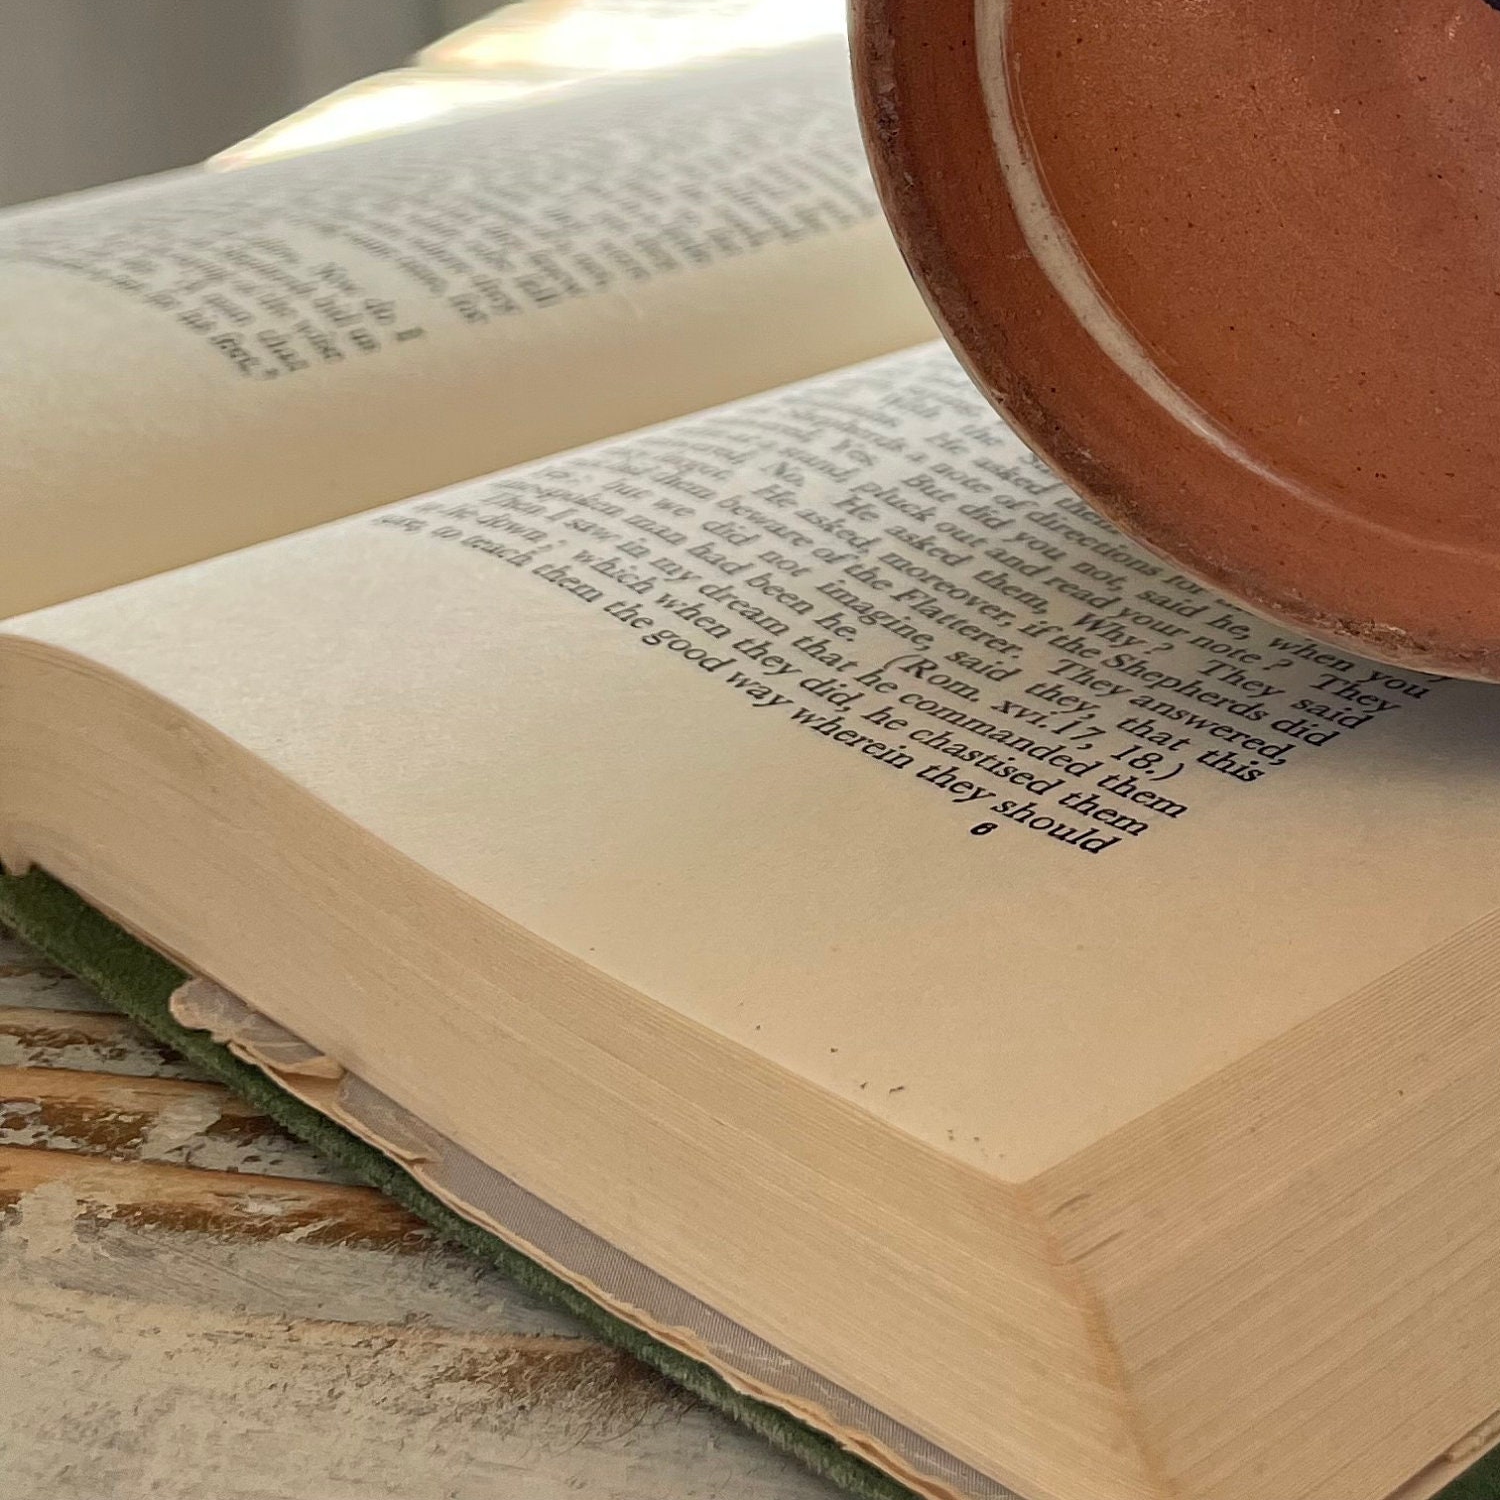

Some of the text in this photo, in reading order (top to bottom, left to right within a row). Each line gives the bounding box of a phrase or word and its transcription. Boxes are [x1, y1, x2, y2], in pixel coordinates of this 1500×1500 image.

[562, 517, 625, 541] saw
[616, 537, 653, 560] in
[650, 557, 704, 582] my
[698, 583, 790, 636] dream
[790, 634, 859, 672] that
[854, 667, 899, 694] he
[898, 691, 1102, 778] commanded
[1096, 772, 1189, 819] them
[624, 514, 688, 545] man
[685, 541, 753, 575] had
[744, 572, 815, 615] been
[813, 611, 859, 642] he.
[882, 653, 980, 703] (Rom.
[1109, 743, 1185, 782] 18.)
[653, 498, 697, 517] we
[702, 518, 762, 547] did
[758, 550, 813, 578] not
[815, 578, 935, 651] imagine,
[944, 649, 1023, 683] said
[1024, 682, 1102, 720] they,
[1116, 716, 1192, 751] that
[1196, 748, 1266, 783] this
[716, 494, 813, 547] beware
[812, 547, 860, 565] of
[844, 561, 893, 591] the
[890, 588, 1023, 659] Flatterer.
[1048, 657, 1133, 698] They
[1128, 691, 1297, 767] answered,
[794, 508, 882, 555] asked,
[878, 551, 1017, 627] moreover,
[1018, 620, 1064, 639] if
[1048, 632, 1101, 660] the
[1100, 652, 1269, 722] Shepherds
[1270, 717, 1341, 747] did
[833, 496, 880, 521] He
[884, 525, 975, 567] asked
[973, 567, 1050, 615] them,
[1198, 658, 1286, 700] They
[1290, 698, 1375, 729] said
[850, 481, 937, 522] pluck
[935, 521, 989, 548] out
[984, 547, 1052, 578] and
[1043, 574, 1122, 610] read
[1106, 606, 1191, 638] your
[1309, 673, 1402, 715] They
[957, 503, 1016, 531] did
[1002, 531, 1067, 562] you
[1071, 561, 1129, 592] not,
[1135, 589, 1209, 618] said
[1205, 613, 1251, 641] he,
[1268, 637, 1355, 673] when
[1357, 669, 1431, 700] you
[1024, 509, 1164, 577] directions
[460, 534, 534, 567] teach
[532, 562, 605, 603] them
[602, 598, 655, 629] the
[641, 627, 737, 672] good
[725, 670, 795, 707] way
[790, 705, 915, 770] wherein
[915, 763, 997, 805] they
[990, 799, 1122, 855] should
[571, 549, 655, 595] which
[653, 592, 733, 639] when
[731, 636, 802, 676] they
[799, 677, 865, 713] did,
[860, 705, 909, 731] he
[908, 727, 1066, 797] chastised
[1057, 790, 1150, 837] them
